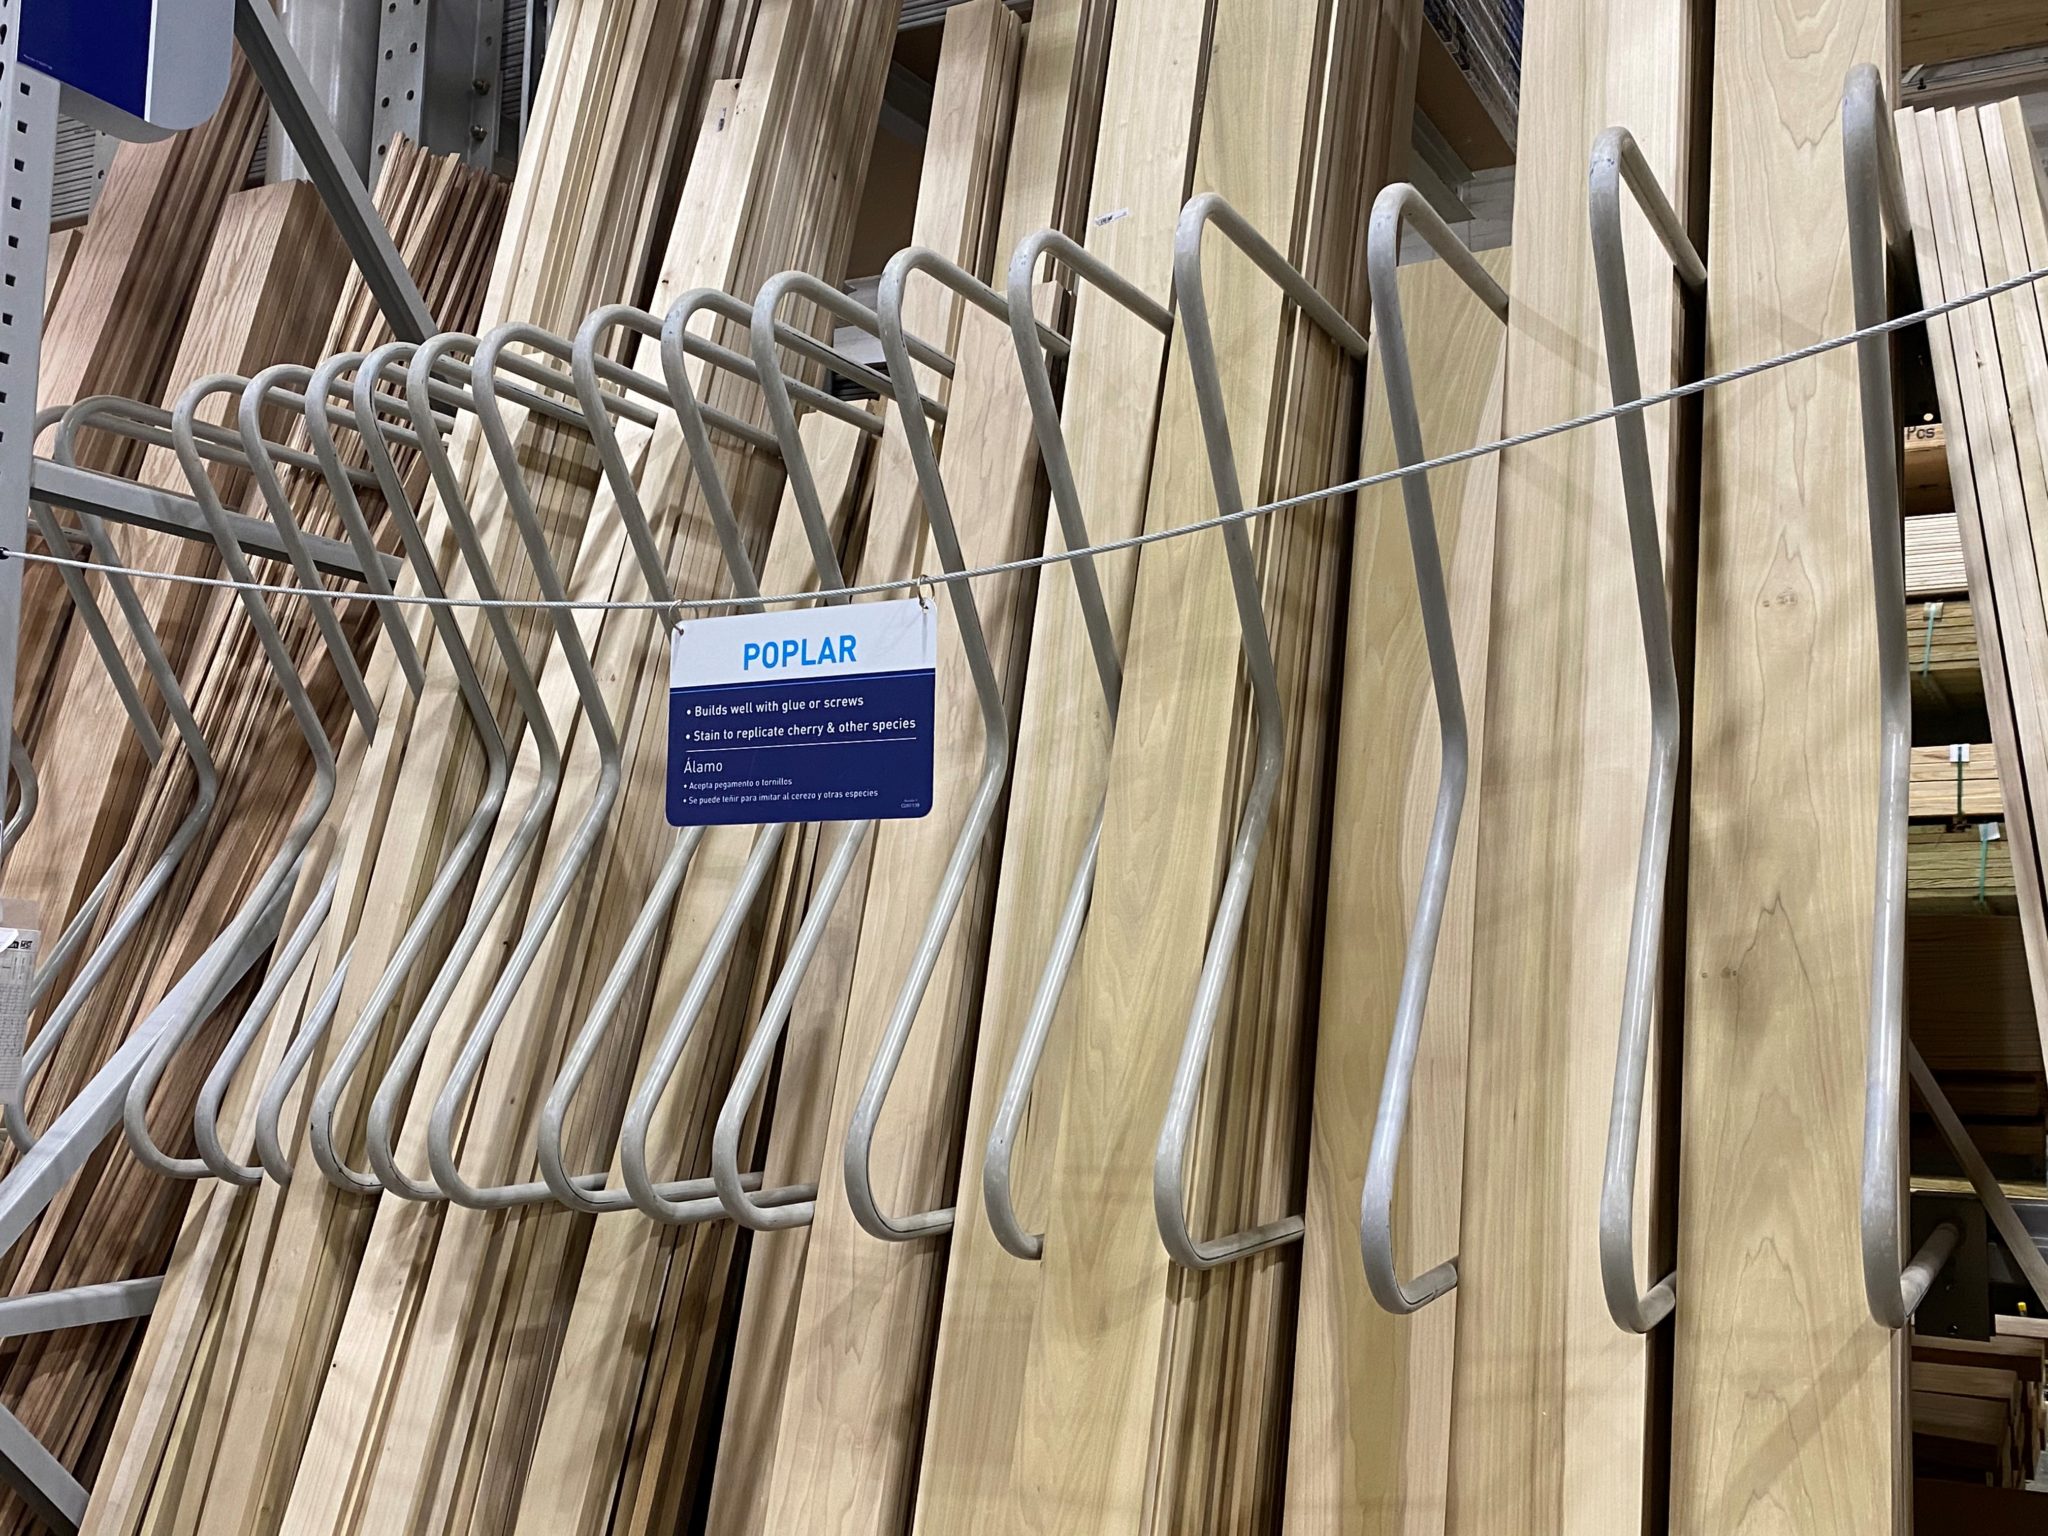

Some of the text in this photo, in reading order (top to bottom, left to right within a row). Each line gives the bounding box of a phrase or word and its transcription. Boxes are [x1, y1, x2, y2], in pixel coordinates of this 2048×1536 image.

[744, 635, 856, 670] POPLAR
[695, 697, 863, 716] Builds well with glue or screws
[694, 718, 915, 741] Stain to replicate cherry & other species
[684, 757, 722, 773] Álamo
[688, 782, 712, 790] Acepta
[714, 780, 754, 790] pegamento
[762, 778, 792, 786] tornillos
[688, 796, 698, 804] Se
[700, 796, 720, 806] puede
[740, 796, 756, 804] para
[782, 792, 790, 800] al
[844, 790, 878, 798] especies
